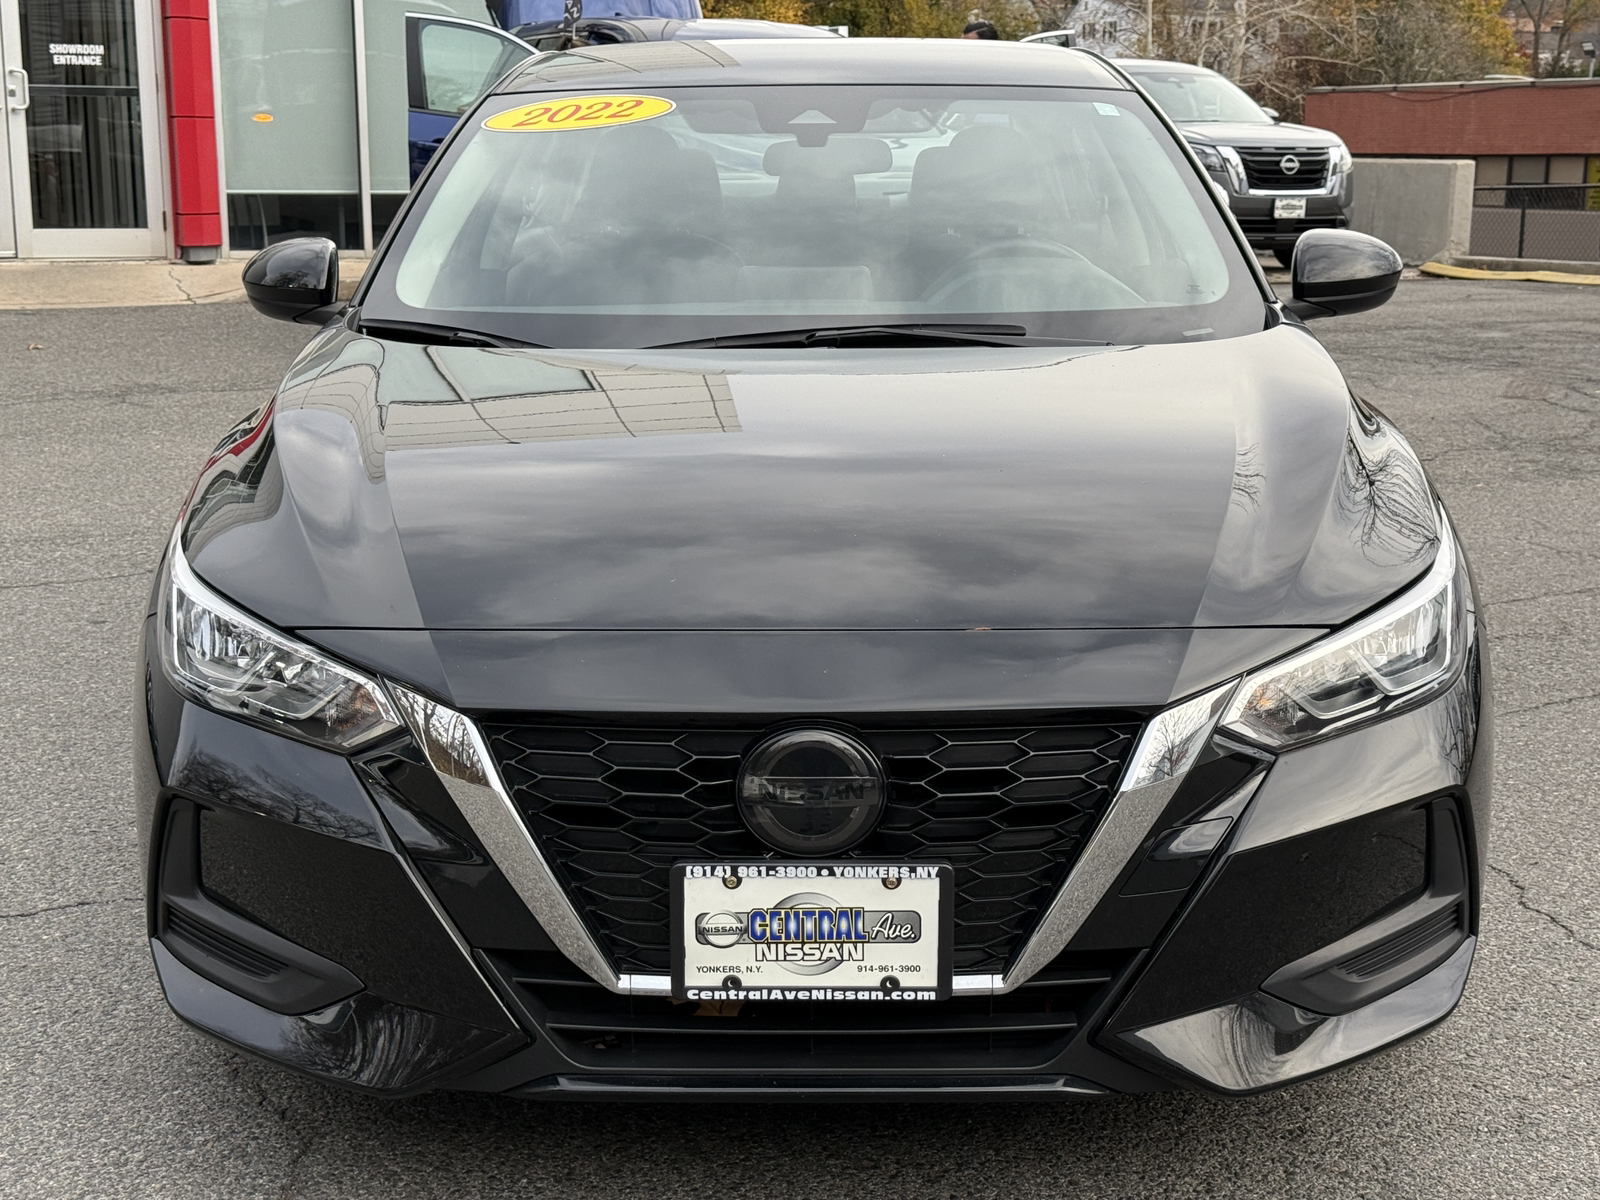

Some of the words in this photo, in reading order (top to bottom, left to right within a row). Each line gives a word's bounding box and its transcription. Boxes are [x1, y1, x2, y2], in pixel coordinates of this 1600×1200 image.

[49, 43, 104, 55] SHOWROOM
[53, 55, 102, 66] ENTRANCE
[511, 99, 644, 128] 2022
[758, 783, 865, 800] NISSAN
[685, 865, 732, 878] (914)
[737, 866, 818, 878] 961-3900
[702, 925, 743, 934] NISSAN
[748, 907, 869, 943] CENTRAL
[871, 912, 916, 940] Ave.
[755, 943, 864, 962] NISSAN
[695, 965, 744, 974] YONKERS,
[745, 965, 764, 974] N.Y.
[857, 965, 921, 973] 914-961-3900
[686, 989, 937, 1001] CentralAveNissan.com
